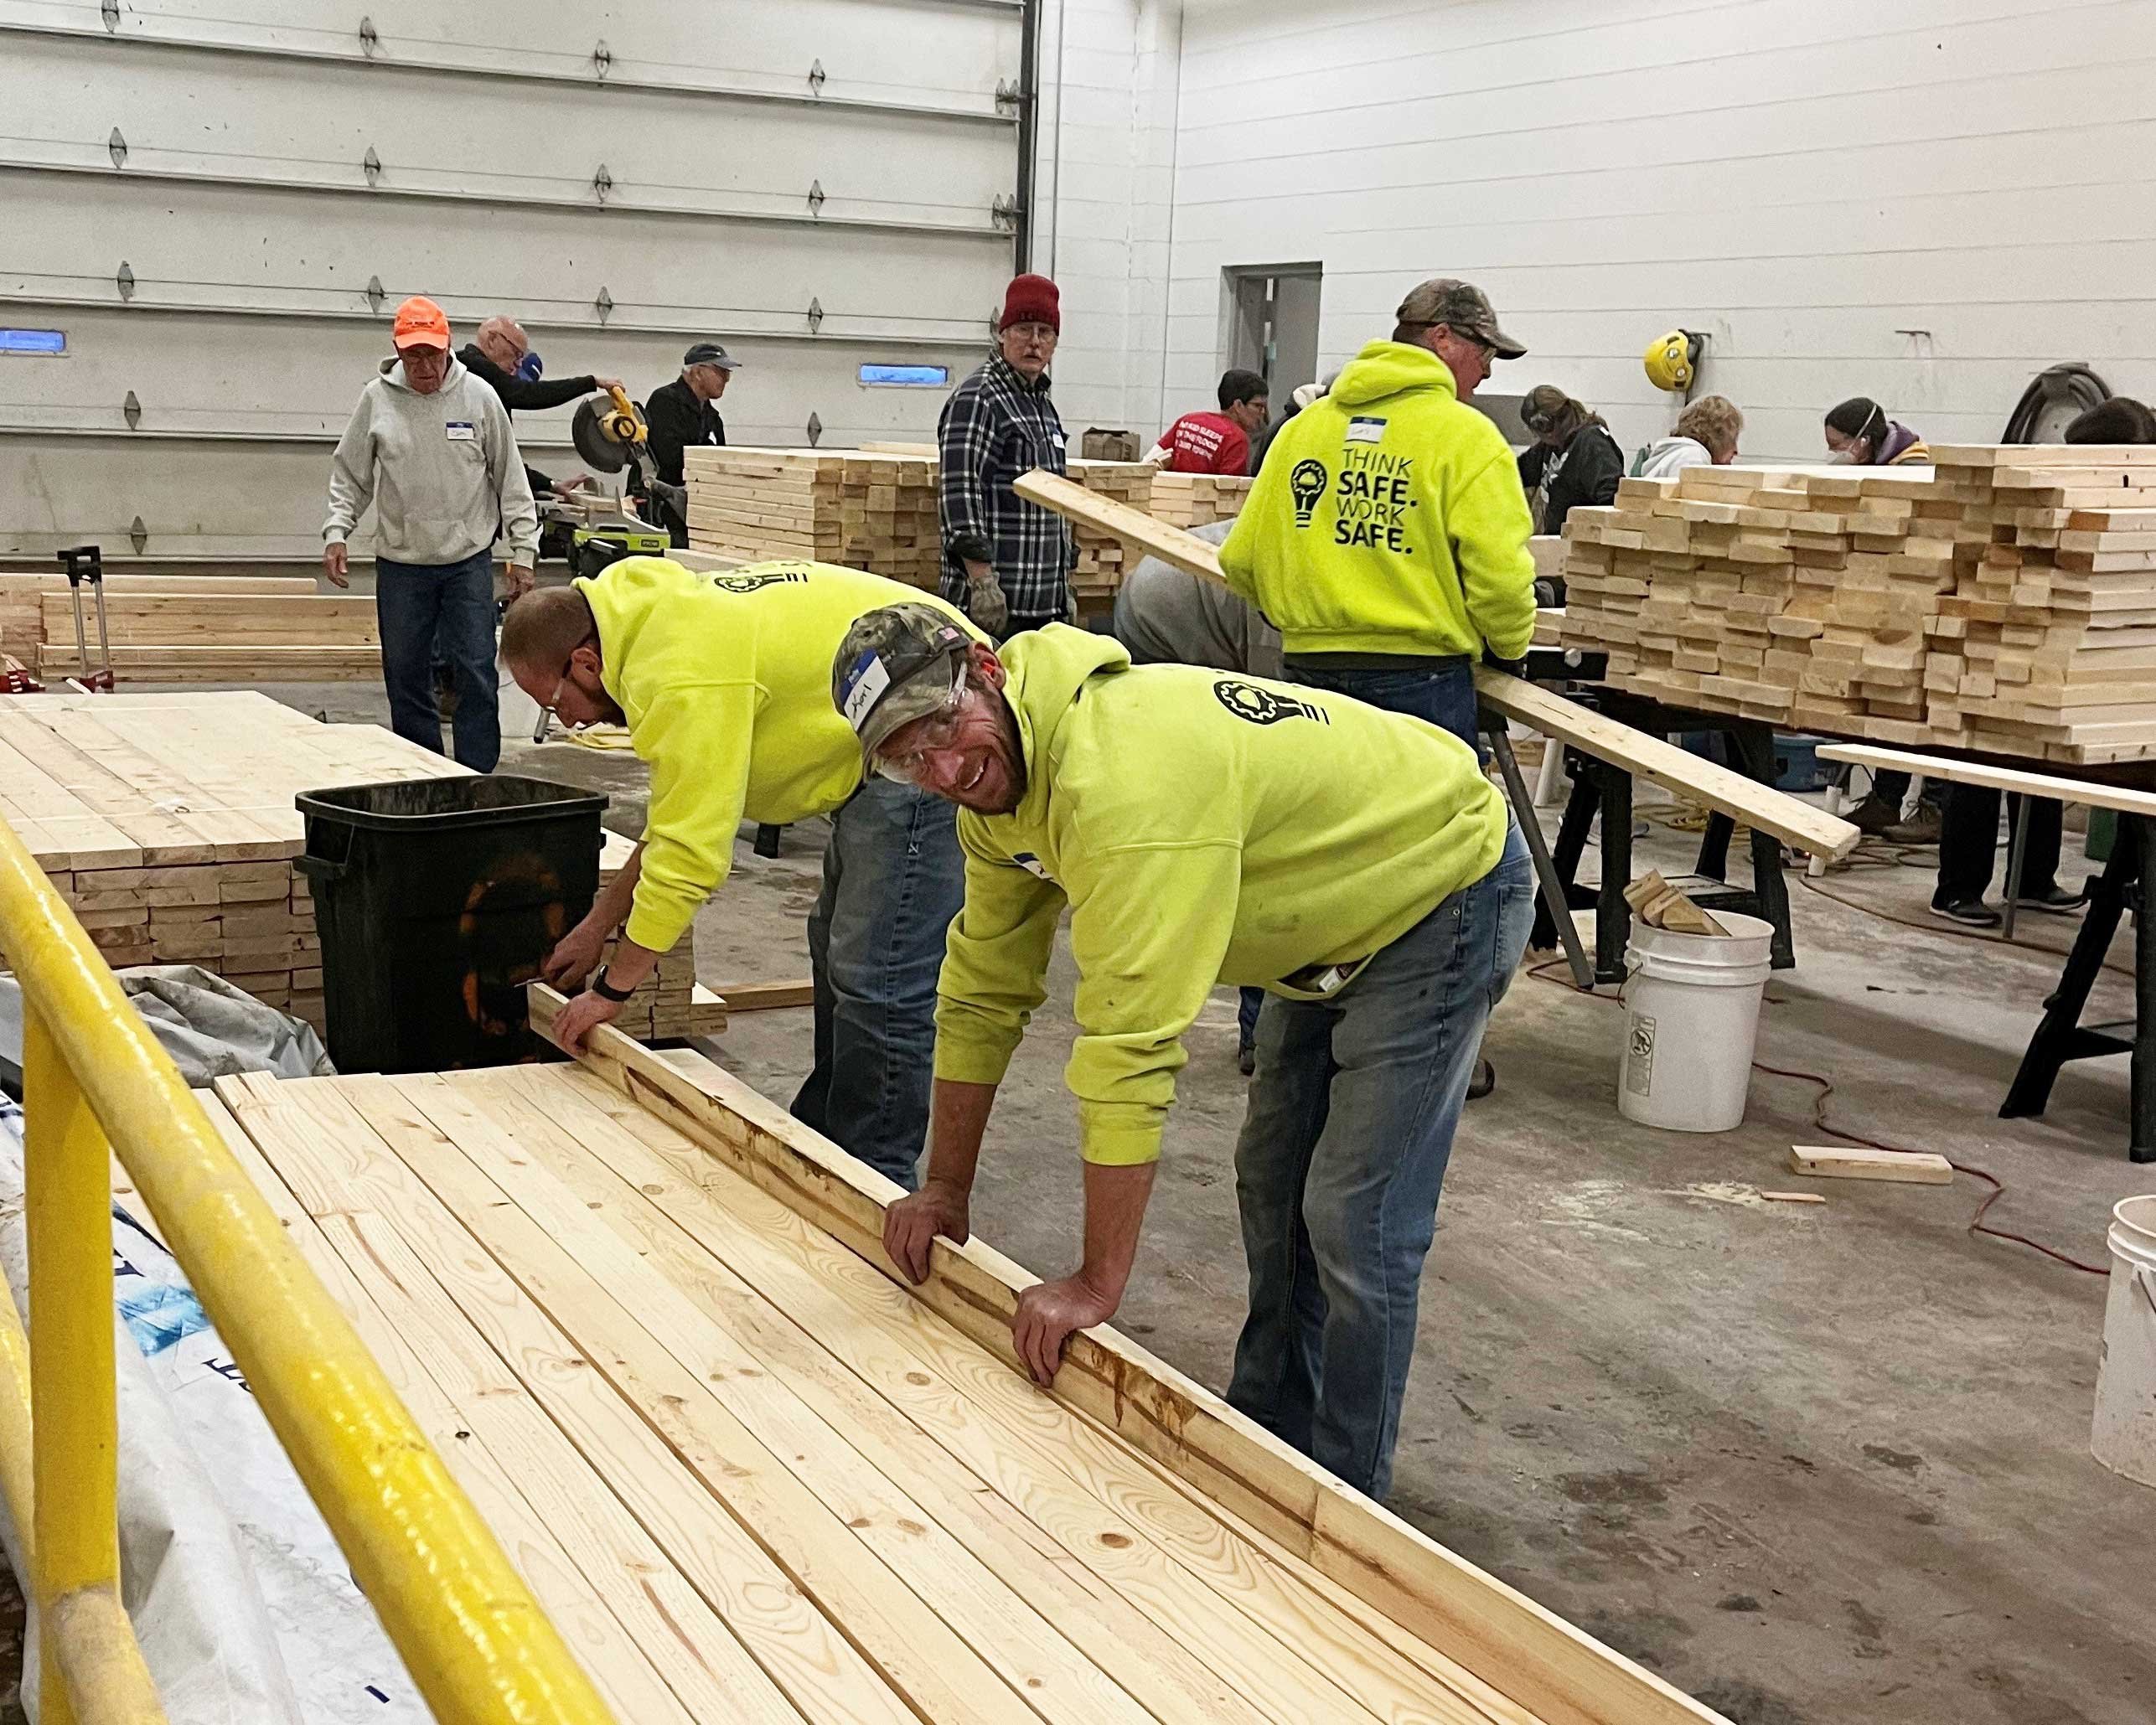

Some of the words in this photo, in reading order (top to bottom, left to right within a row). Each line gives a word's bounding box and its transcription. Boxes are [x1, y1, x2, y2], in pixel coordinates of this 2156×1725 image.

[1342, 447, 1414, 478] THINK
[1337, 471, 1418, 507] SAFE.
[1337, 497, 1405, 527] WORK
[1335, 519, 1413, 555] SAFE.
